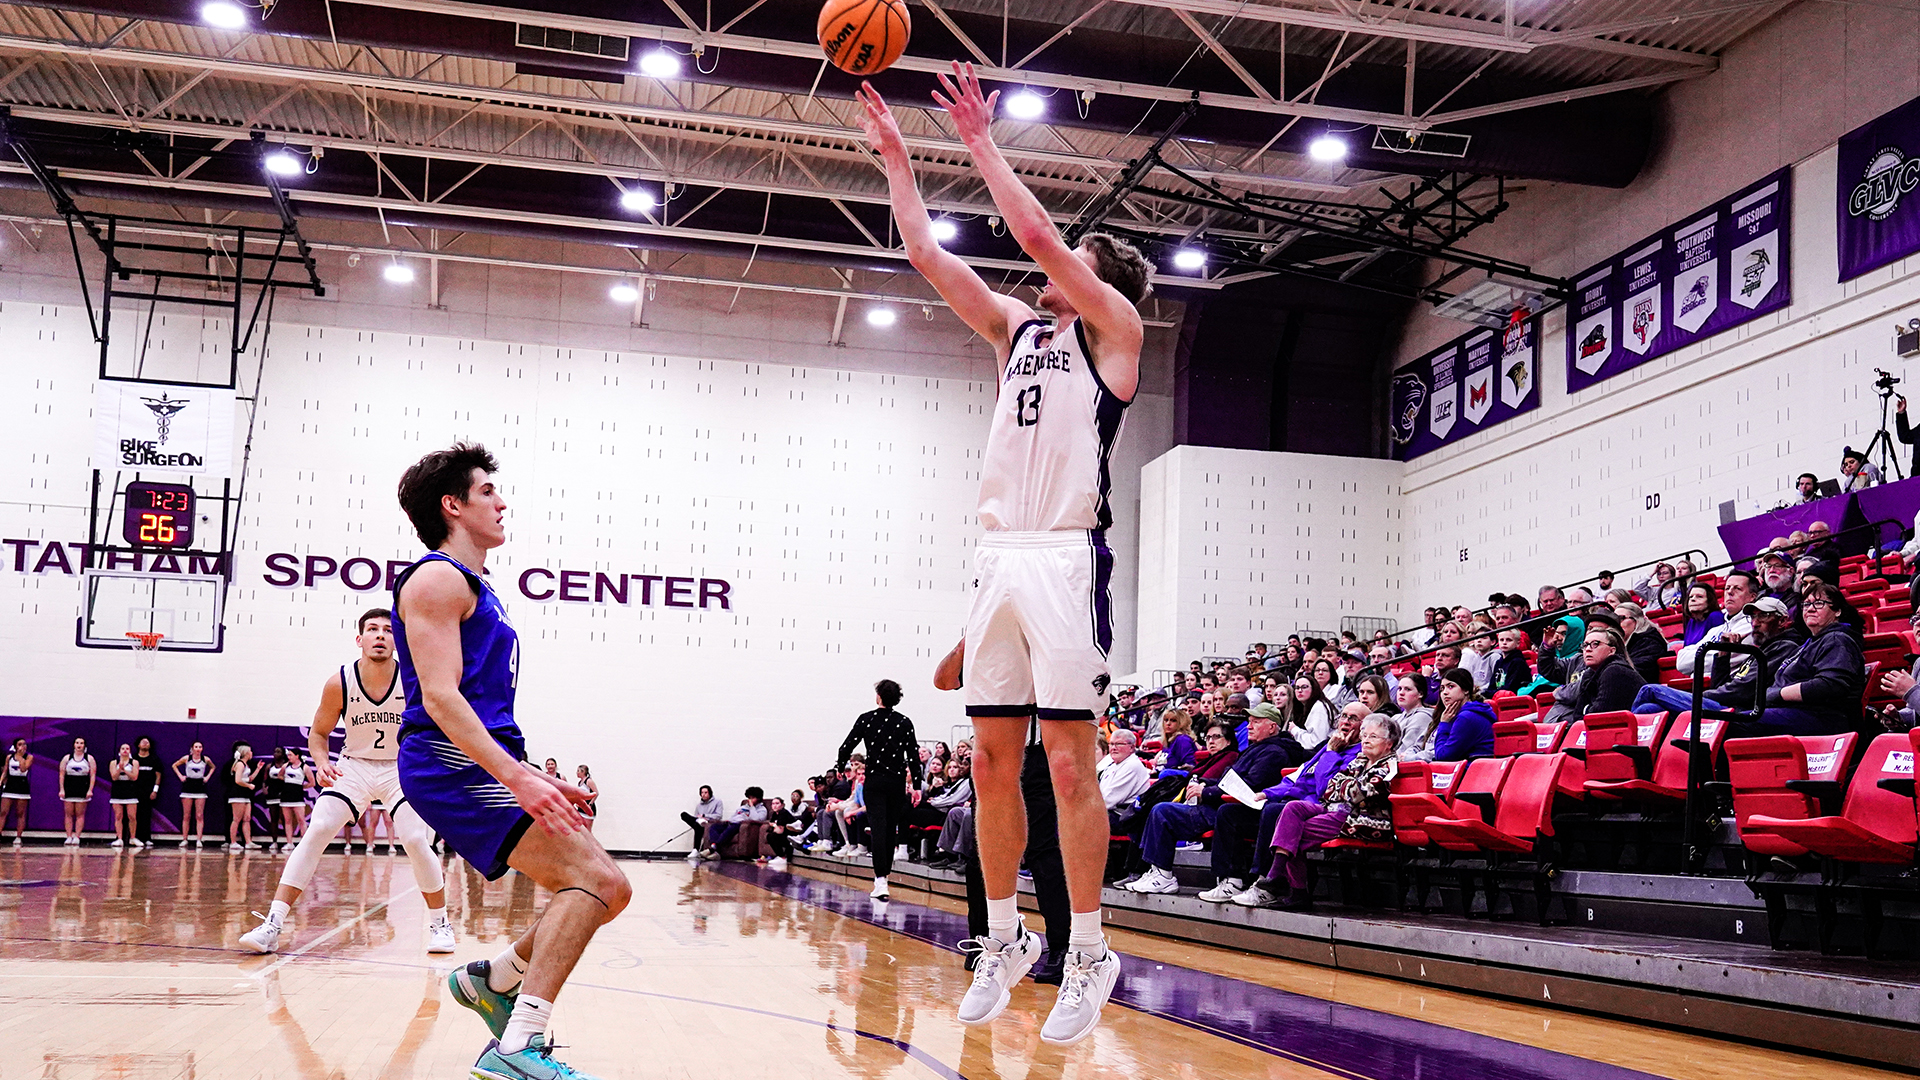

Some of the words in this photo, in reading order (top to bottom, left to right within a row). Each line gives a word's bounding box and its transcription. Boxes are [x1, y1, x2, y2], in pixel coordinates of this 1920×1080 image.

[1849, 158, 1920, 216] GLVC
[1738, 201, 1772, 230] MISSOURI
[1748, 222, 1760, 236] S&T
[1677, 226, 1715, 254] SOUTHWEST
[1685, 242, 1707, 260] BAPTIST
[1680, 250, 1712, 271] UNIVERSITY
[1634, 261, 1652, 279] LEWIS
[1629, 271, 1657, 292] UNIVERSITY
[1016, 384, 1041, 427] 13
[120, 438, 158, 453] BIKE
[122, 450, 203, 467] SURGEON
[146, 490, 188, 511] 7:23
[1646, 493, 1660, 511] DD
[139, 513, 175, 542] 26
[1459, 548, 1469, 562] EE
[2, 538, 232, 582] TATHAM
[263, 553, 490, 592] SPO
[518, 568, 731, 610] CENTER
[351, 711, 402, 726] McKENDRE
[374, 728, 385, 749] 2
[1587, 908, 1594, 921] B
[1735, 919, 1744, 934] B
[1420, 963, 1426, 977] A
[1543, 983, 1551, 1000] A
